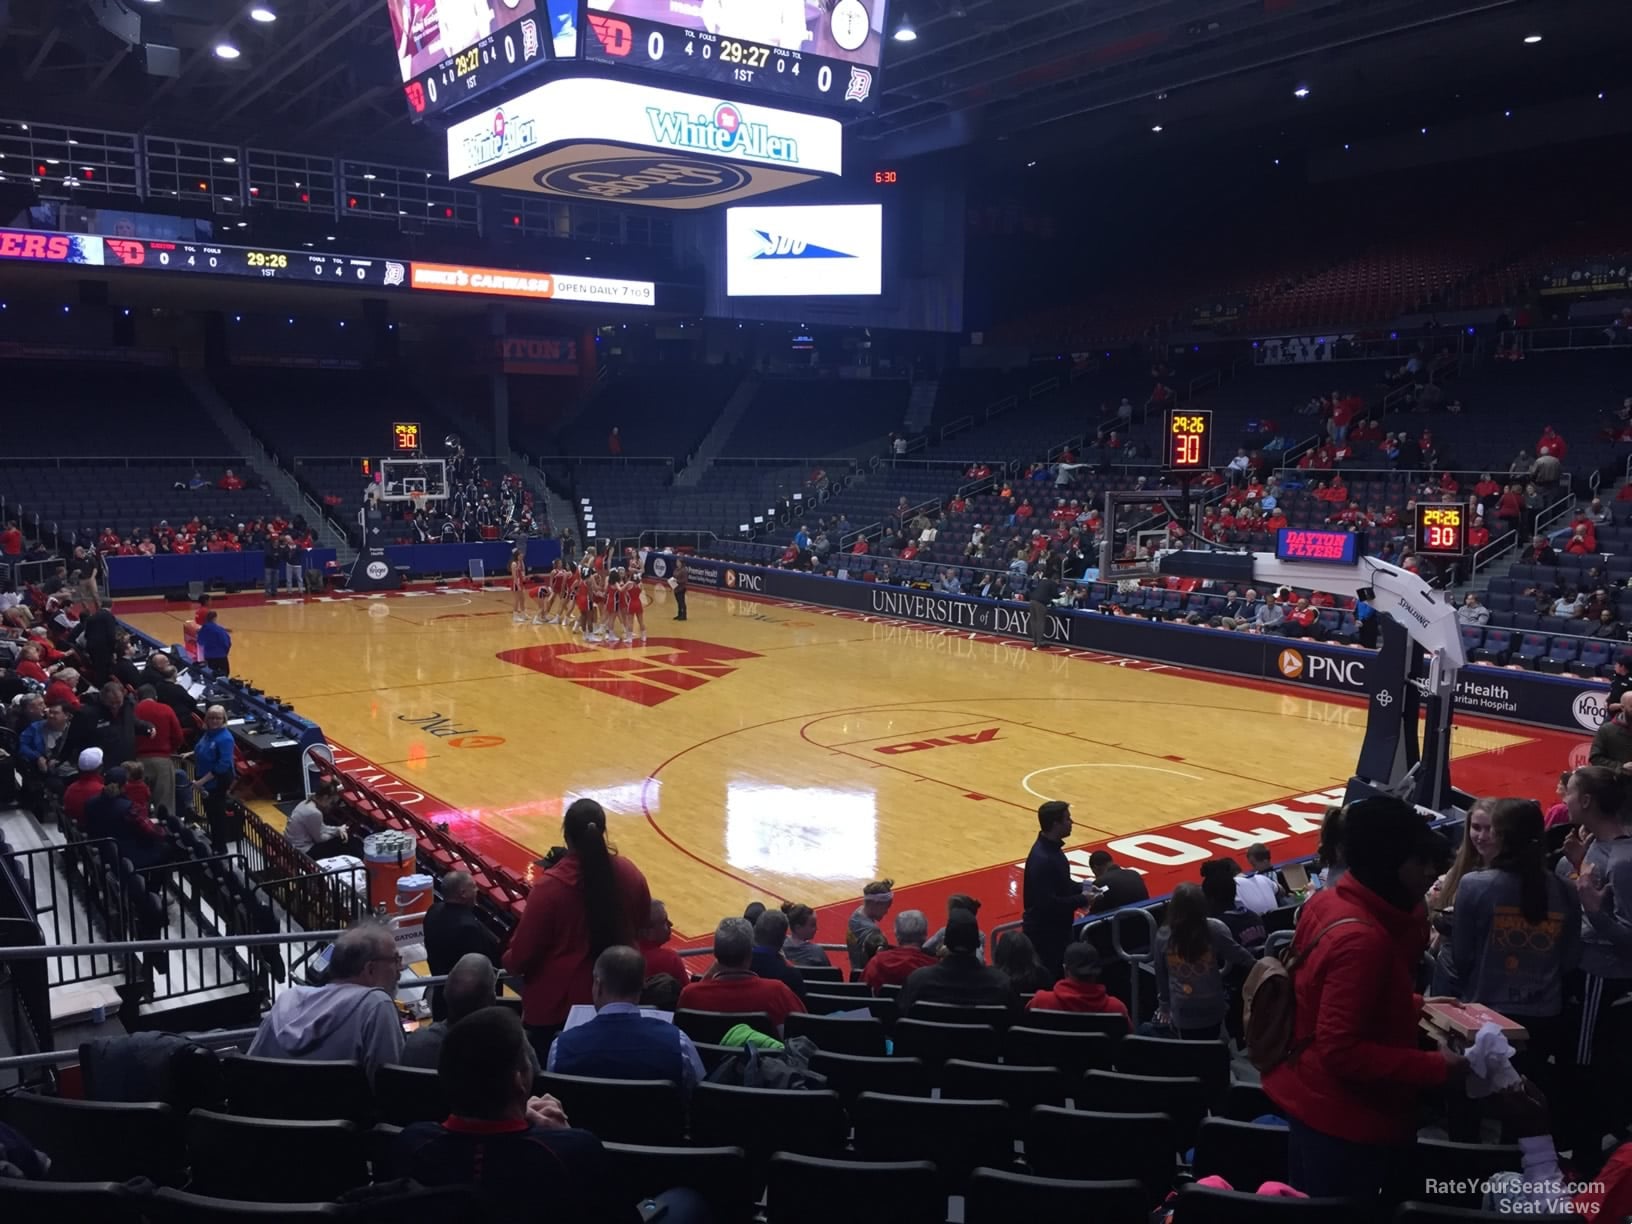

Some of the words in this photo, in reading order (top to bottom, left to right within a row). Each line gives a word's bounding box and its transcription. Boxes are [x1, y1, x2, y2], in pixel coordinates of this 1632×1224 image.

[504, 35, 515, 63] 0
[648, 31, 664, 60] 0
[684, 41, 694, 56] 4
[702, 44, 711, 59] 0
[719, 40, 770, 68] 29:27
[455, 48, 480, 77] 29:27
[482, 51, 489, 64] 0
[491, 46, 497, 60] 4
[734, 68, 754, 82] 1ST
[777, 59, 785, 73] 0
[791, 62, 800, 76] 4
[442, 73, 448, 86] 4
[449, 69, 455, 82] 0
[466, 75, 477, 89] 1ST
[817, 65, 832, 92] 0
[427, 77, 437, 102] 0
[875, 171, 897, 183] 6:30
[0, 232, 70, 259] ERS
[160, 252, 169, 265] 0
[188, 256, 195, 266] 4
[209, 257, 217, 267] 0
[247, 252, 287, 268] 29:26
[261, 269, 275, 277] 1ST
[315, 265, 322, 275] 0
[335, 267, 342, 276] 4
[357, 268, 366, 279] 0
[558, 282, 587, 294] OPEN
[590, 285, 618, 296] DAILY
[622, 286, 628, 296] 7
[643, 287, 650, 298] 9
[1173, 416, 1204, 433] 29:26
[400, 433, 415, 448] 30
[1176, 435, 1200, 463] 30
[1424, 510, 1460, 526] 29:26
[1286, 531, 1347, 547] DAYTON
[1431, 527, 1454, 546] 30
[1286, 543, 1343, 559] FLYERS
[739, 572, 762, 591] PNC
[872, 590, 978, 626] UNIVERSITY
[979, 610, 990, 626] of
[994, 607, 1071, 641] DAYON
[1399, 597, 1430, 629] SPALDING
[1307, 655, 1365, 686] PNC
[1464, 681, 1509, 699] Health
[1454, 695, 1478, 705] aritan
[1480, 698, 1517, 712] Hospital
[394, 930, 423, 942] GATORA
